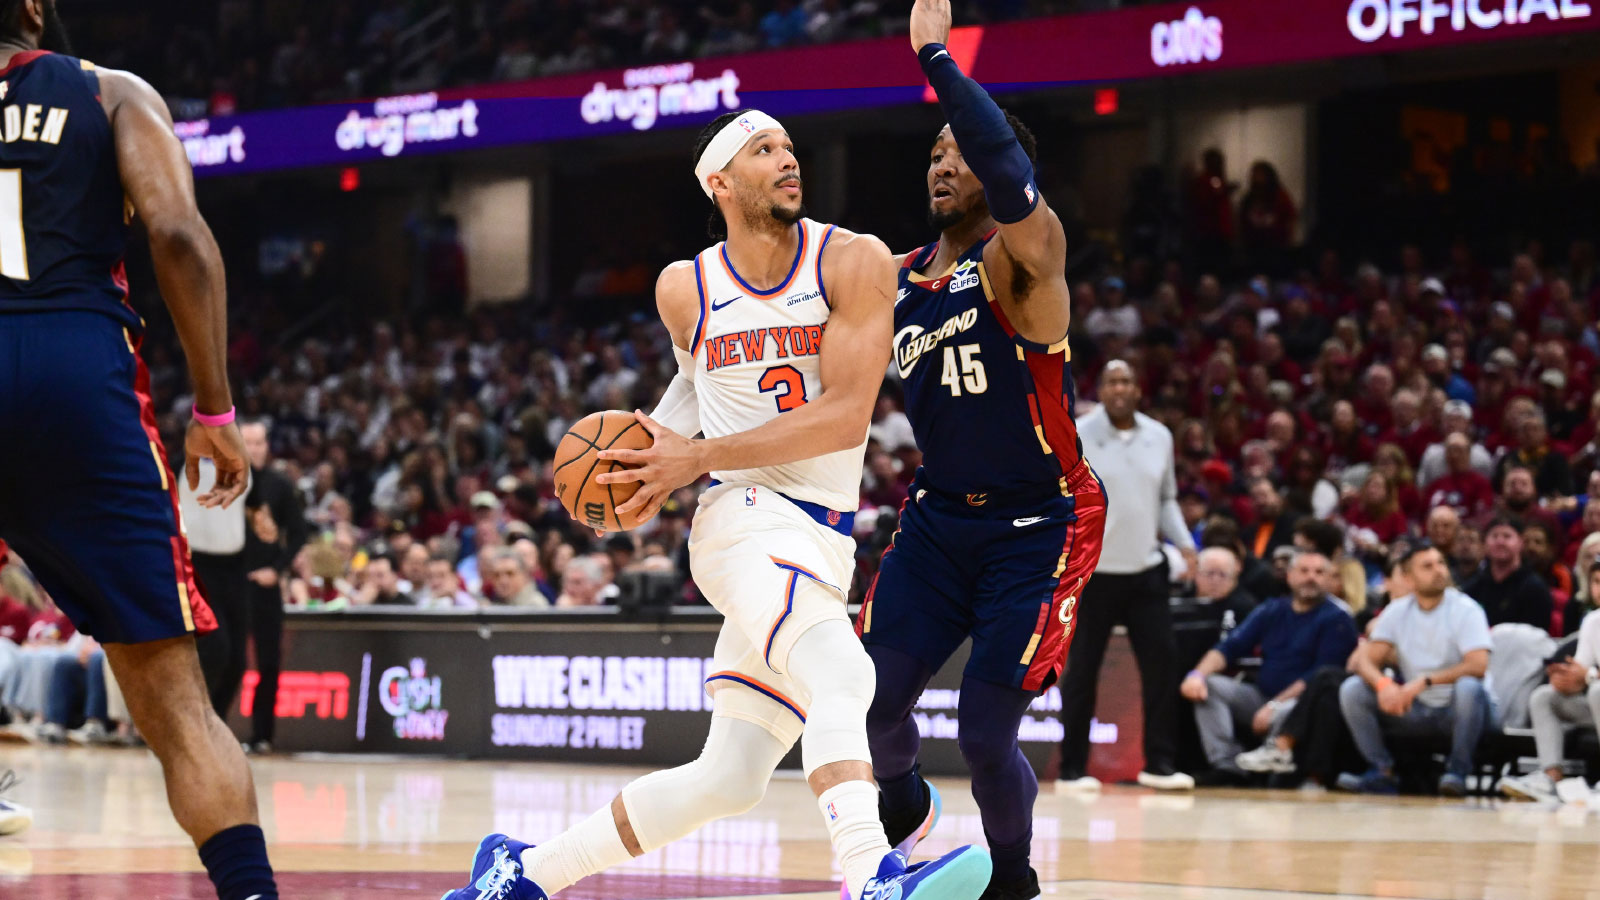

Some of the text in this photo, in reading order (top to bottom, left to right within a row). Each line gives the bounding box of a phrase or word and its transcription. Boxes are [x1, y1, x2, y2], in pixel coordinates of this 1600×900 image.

[0, 103, 69, 145] DEN
[581, 68, 740, 131] drug mart
[335, 98, 479, 156] drug mart
[801, 290, 821, 302] dhab
[950, 275, 979, 291] CLIFFS
[705, 321, 828, 372] NEW YOR
[892, 307, 979, 380] CLEVEAND
[757, 364, 809, 413] 3
[940, 343, 989, 397] 45
[492, 655, 569, 709] WWE
[569, 656, 665, 711] CLASH
[491, 713, 646, 750] SUNDAY 2 PM ET
